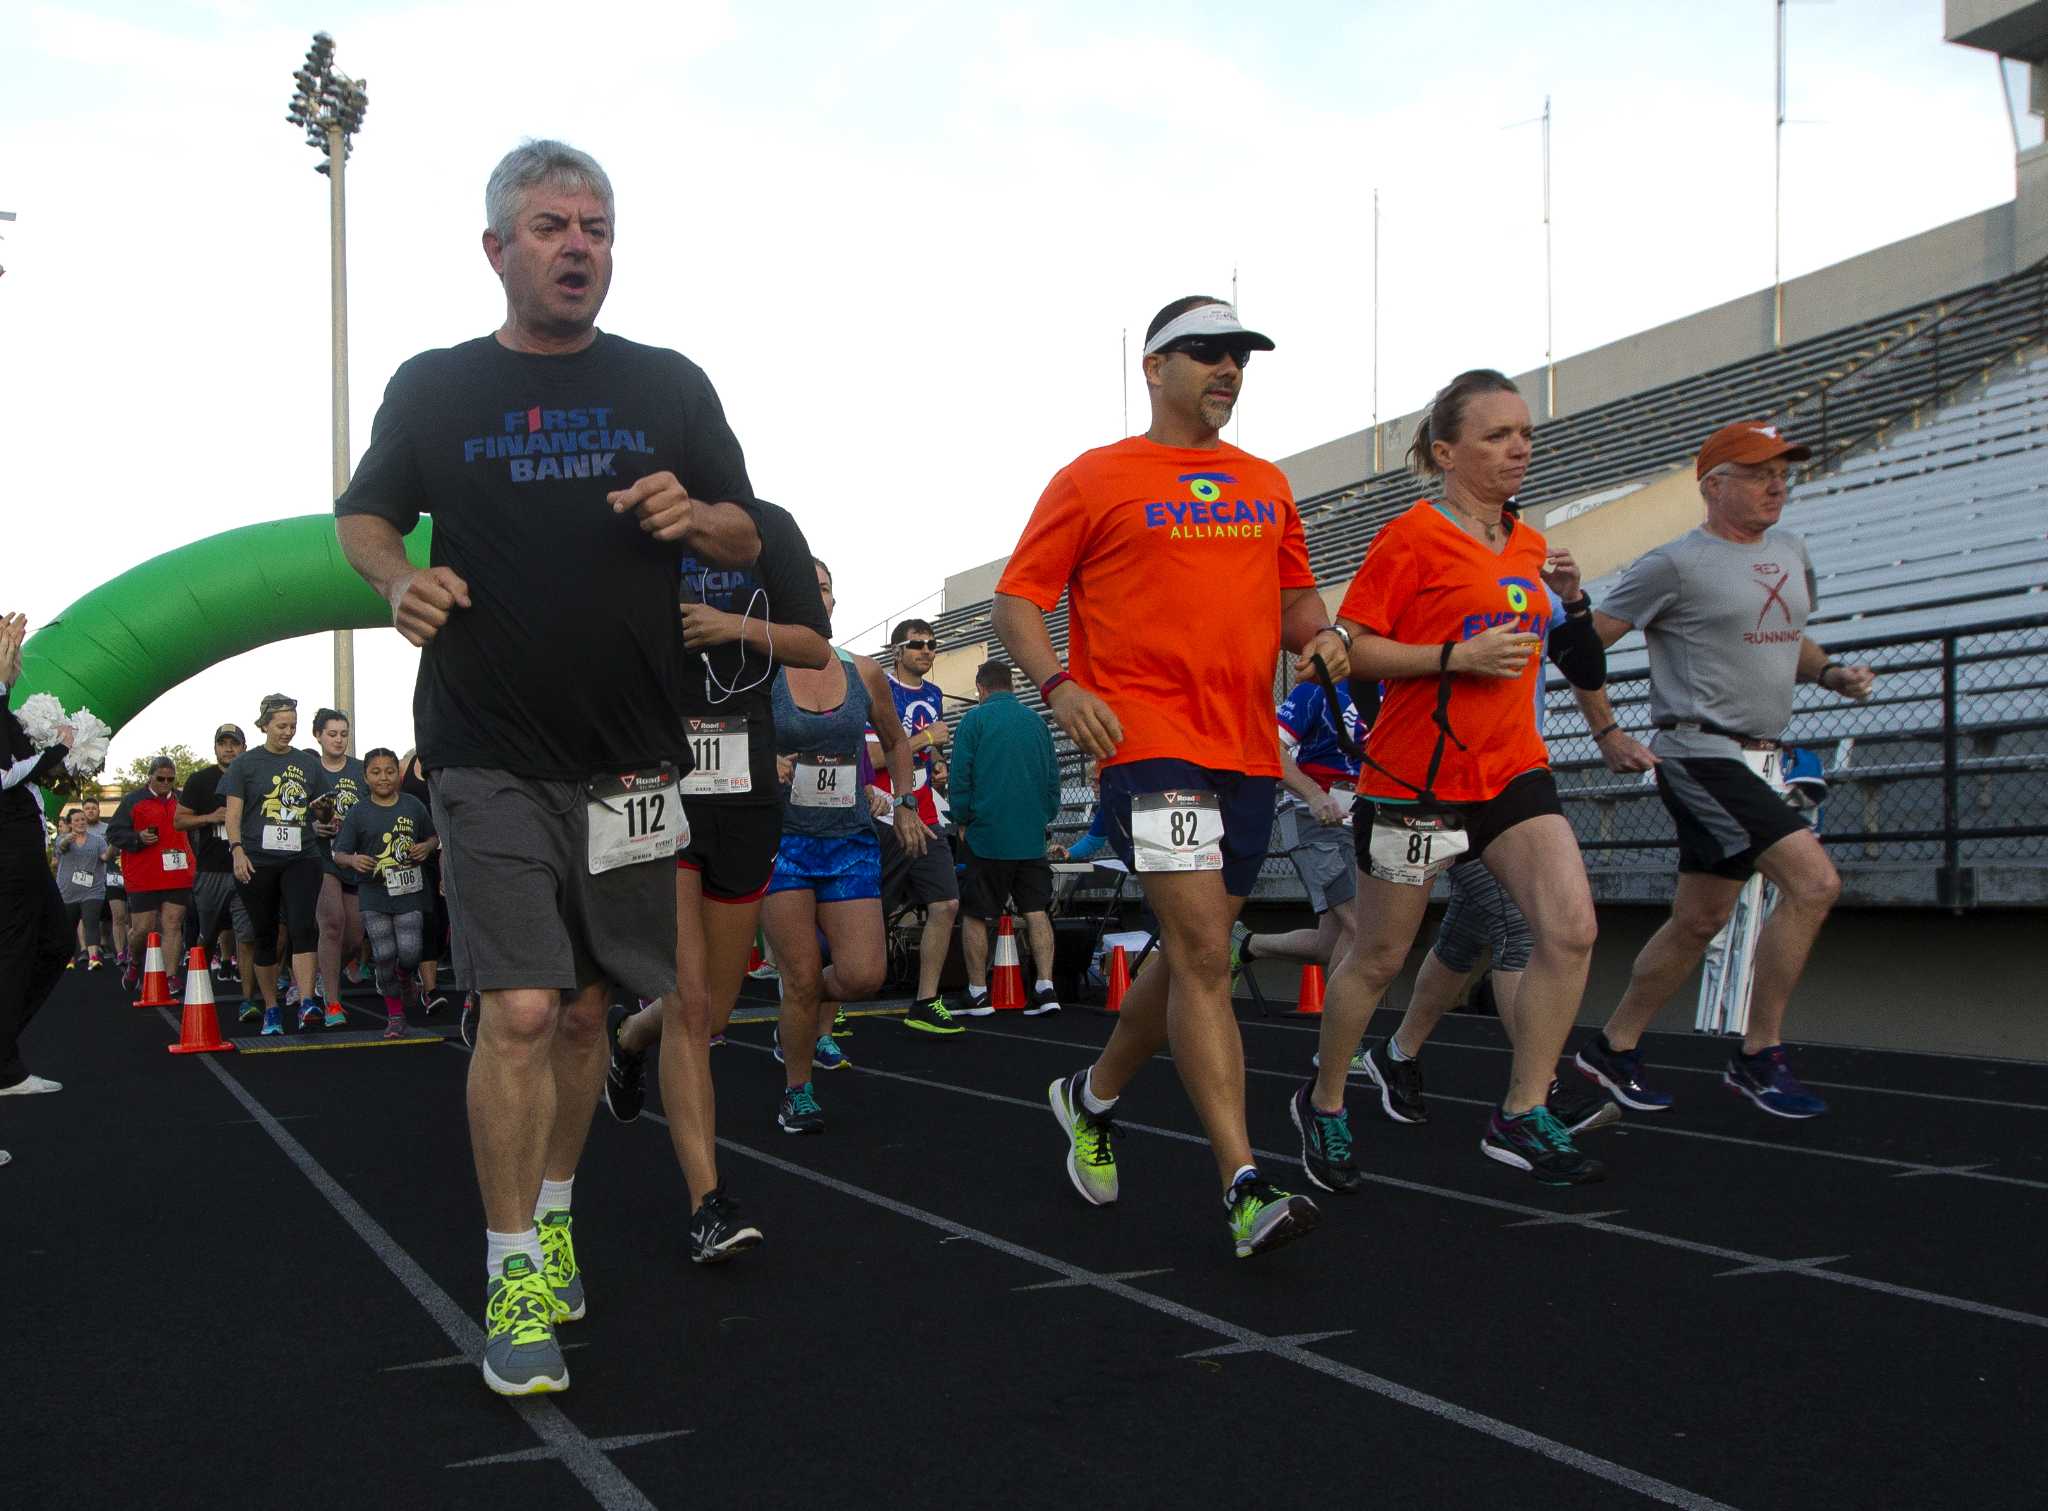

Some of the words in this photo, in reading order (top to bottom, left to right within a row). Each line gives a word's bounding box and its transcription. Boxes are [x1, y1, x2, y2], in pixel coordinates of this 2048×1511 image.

[504, 406, 612, 433] FIRST
[464, 430, 655, 462] FINANCIAL
[509, 453, 616, 483] BANK
[1145, 500, 1276, 527] EYECAN
[1170, 525, 1263, 540] ALLIANCE
[693, 737, 720, 771] 111
[817, 768, 837, 791] 84
[623, 793, 666, 838] 112
[1170, 811, 1199, 846] 82
[276, 827, 289, 841] 35
[1406, 833, 1433, 865] 81
[400, 870, 416, 886] 106
